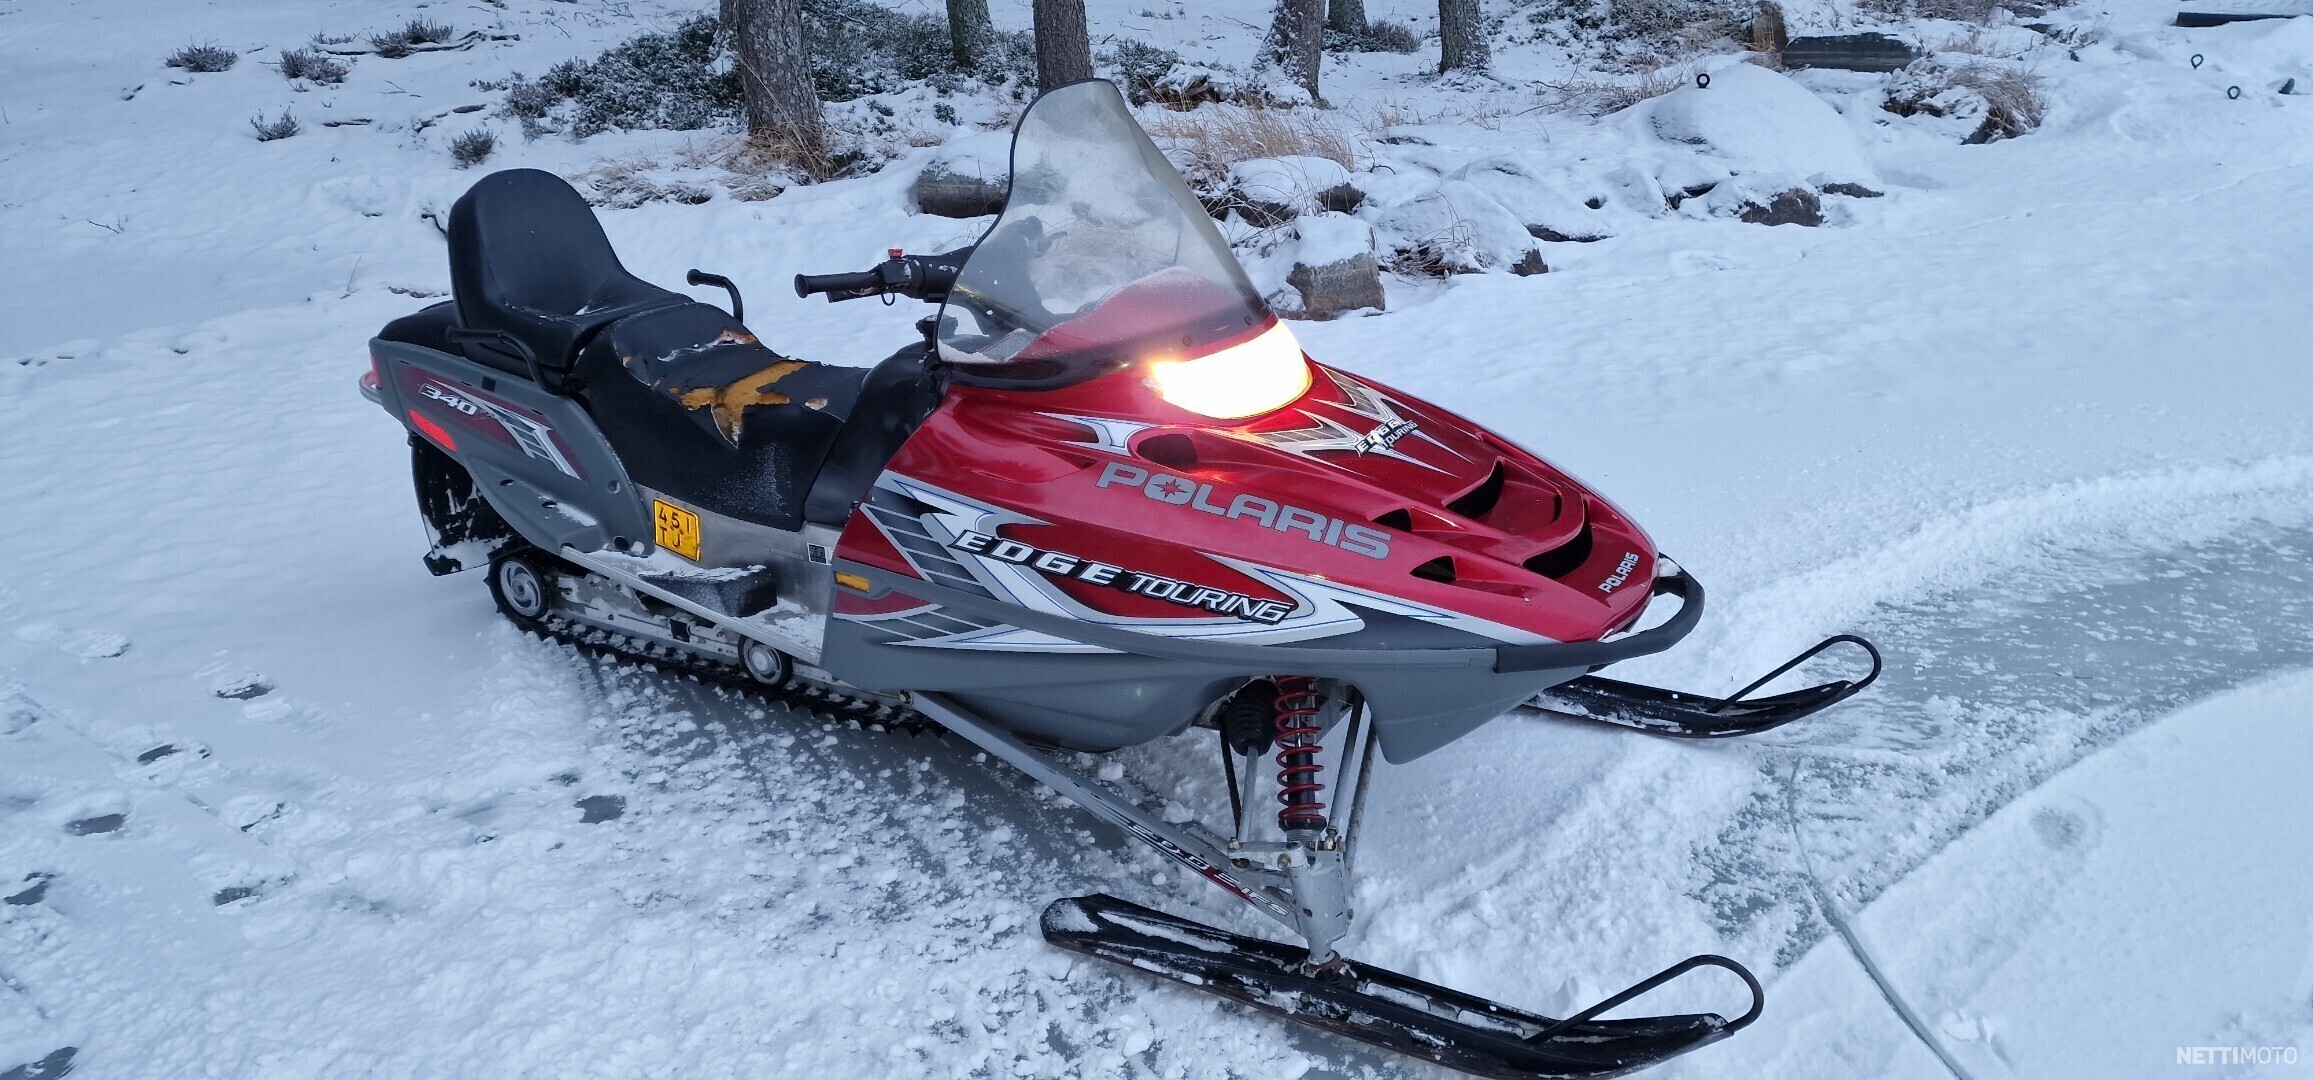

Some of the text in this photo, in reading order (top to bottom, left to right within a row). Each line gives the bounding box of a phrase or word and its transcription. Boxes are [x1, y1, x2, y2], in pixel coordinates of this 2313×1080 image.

[421, 384, 477, 415] 340
[1382, 420, 1418, 448] TOURING
[1095, 461, 1391, 560] POLARIS
[659, 526, 682, 547] TJ
[955, 529, 1294, 622] EDGE TOURING
[1598, 552, 1639, 593] POLARIS
